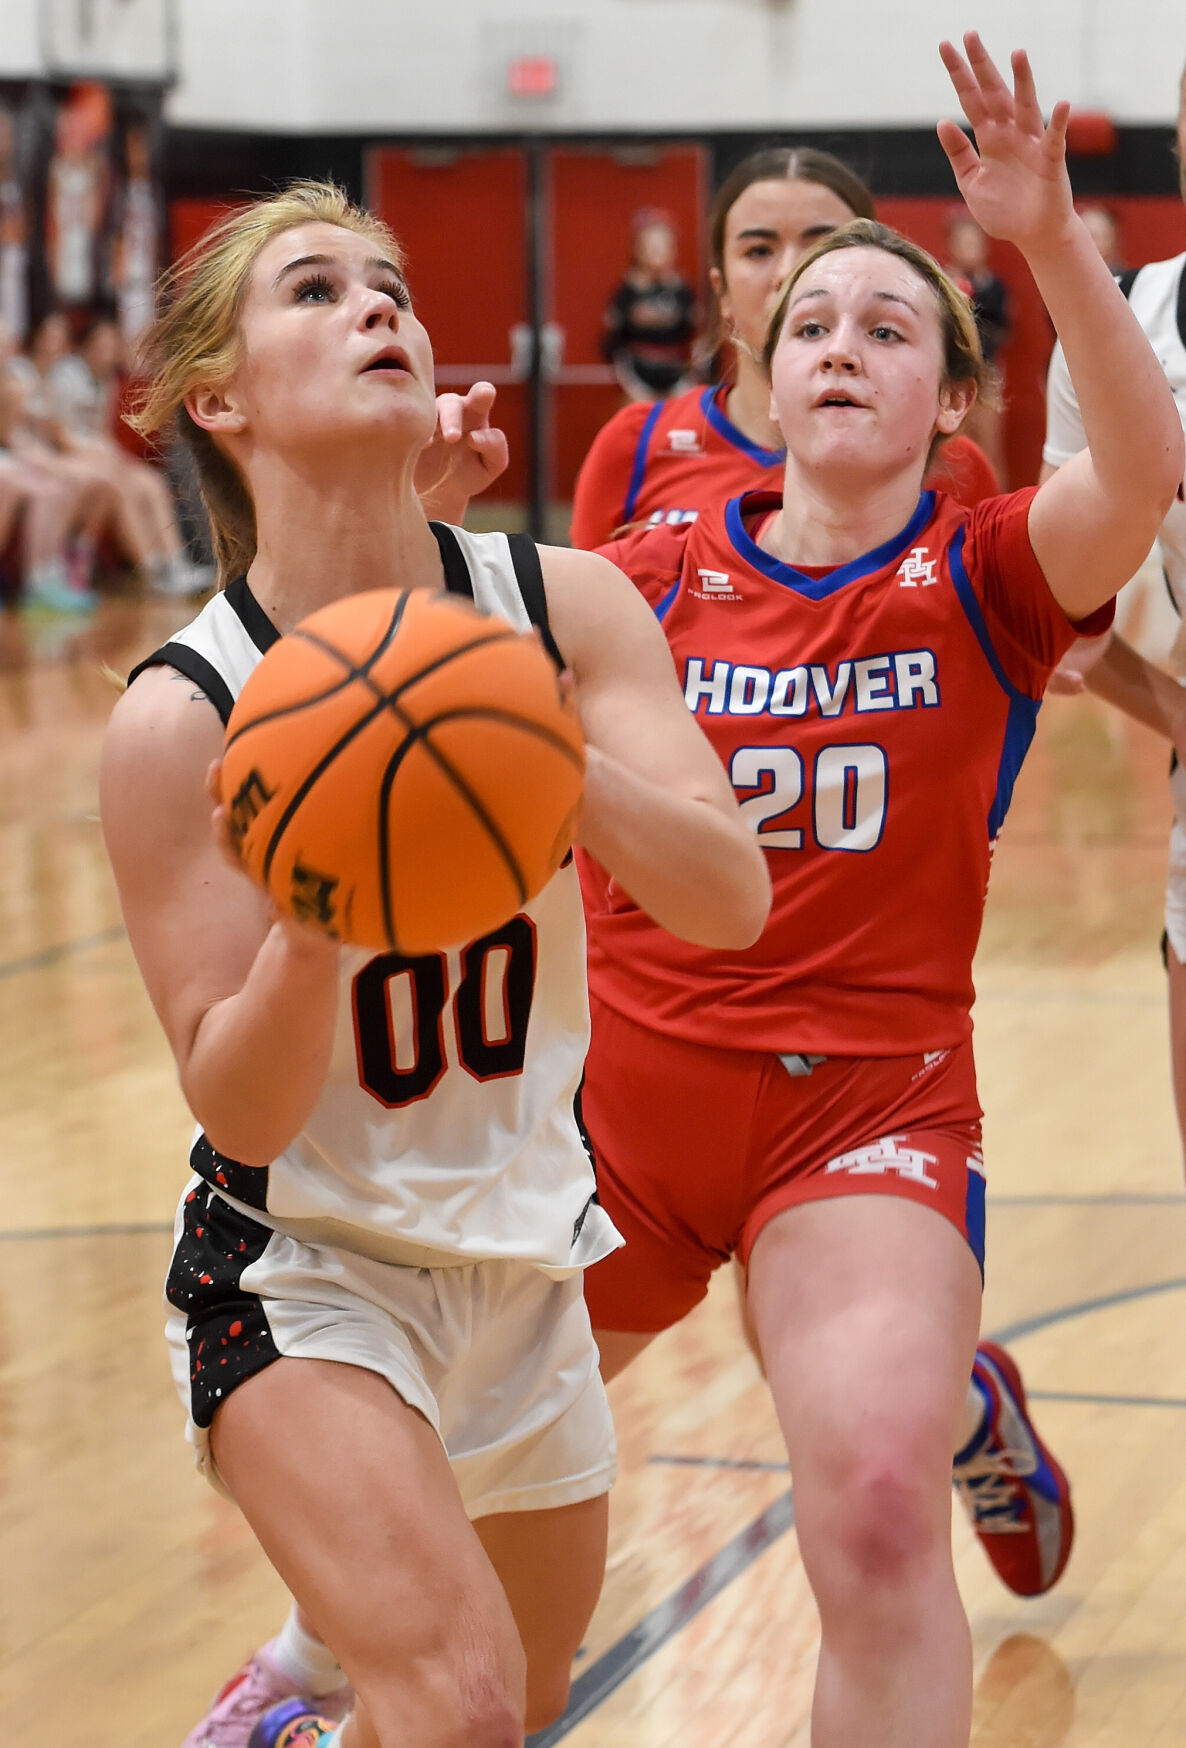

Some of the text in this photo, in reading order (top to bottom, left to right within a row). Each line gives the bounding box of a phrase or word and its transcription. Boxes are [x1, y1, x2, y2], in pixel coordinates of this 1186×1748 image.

[684, 648, 942, 718] HOOVER
[730, 743, 889, 853] 20
[351, 912, 537, 1109] 00
